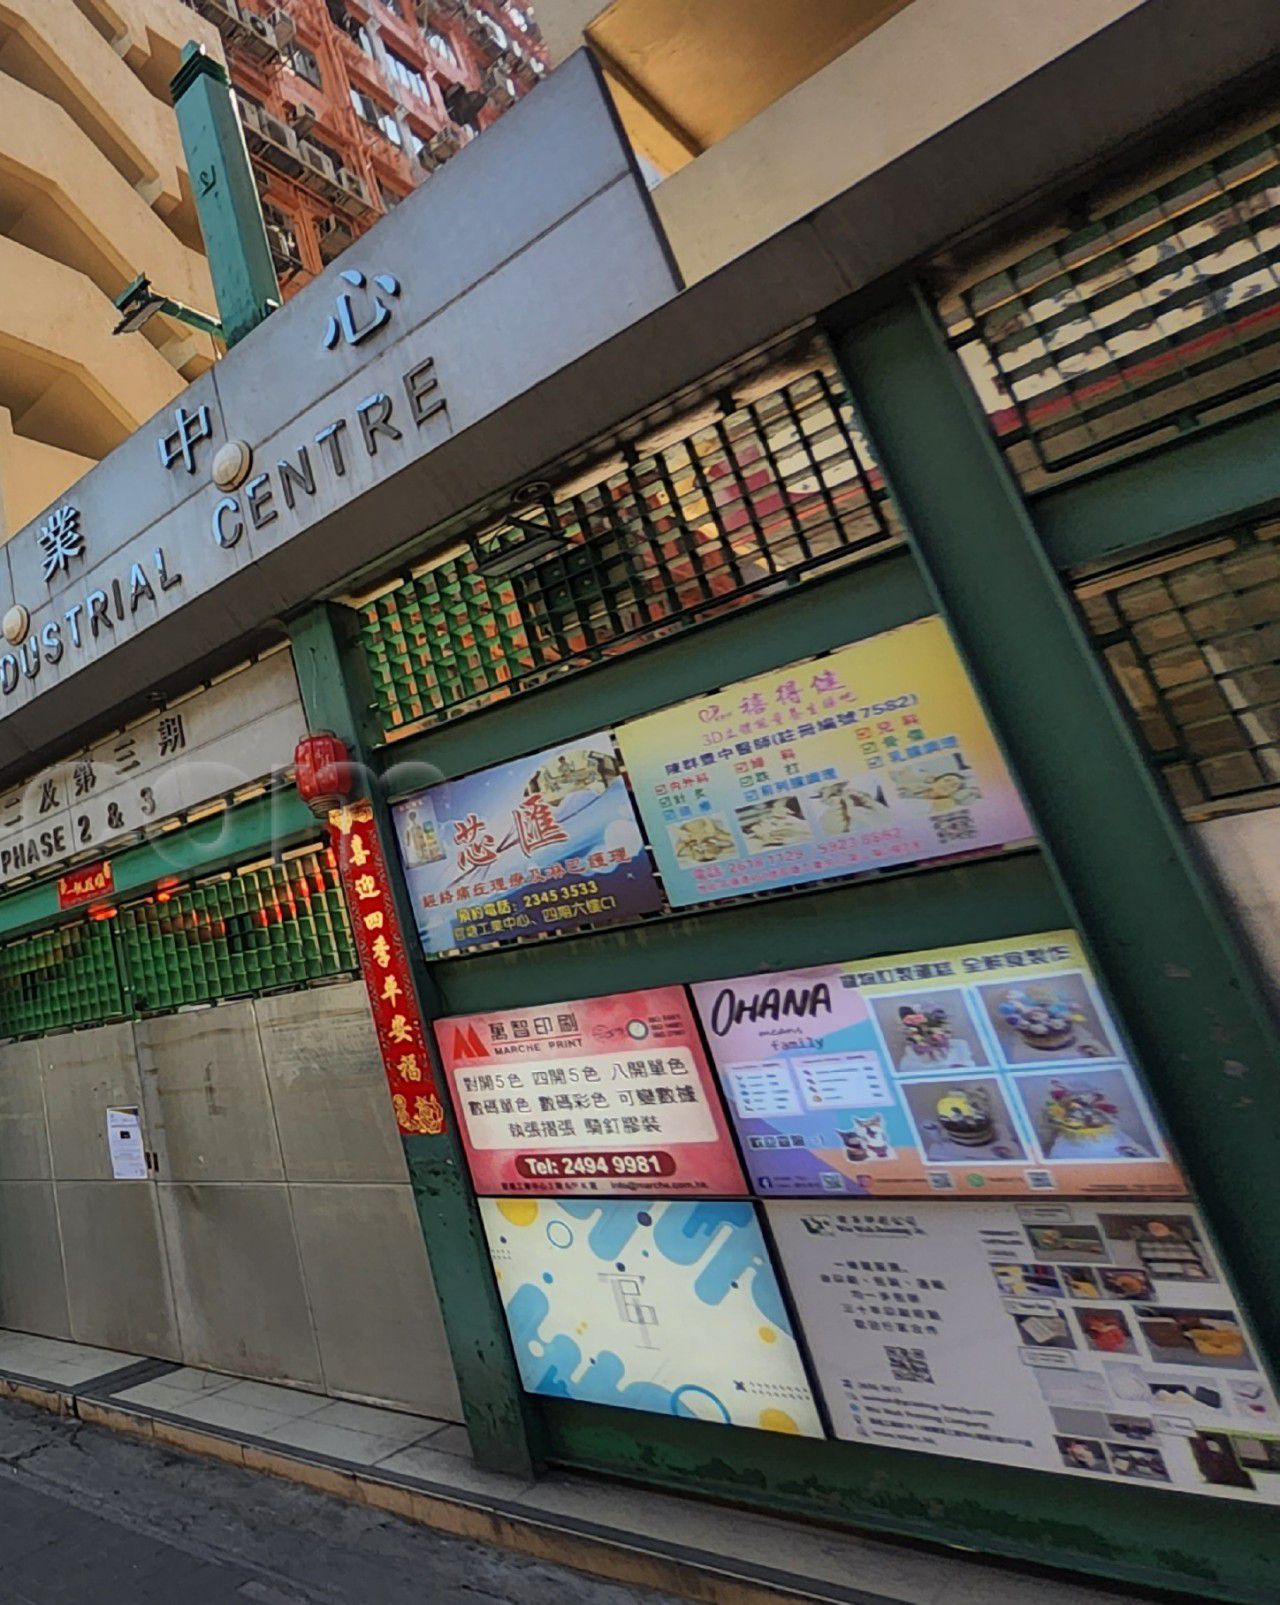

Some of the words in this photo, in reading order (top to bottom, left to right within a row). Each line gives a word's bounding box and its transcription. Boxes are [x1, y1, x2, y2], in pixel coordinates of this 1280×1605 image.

[211, 356, 449, 551] CENTRE
[0, 825, 67, 875] PHASE
[77, 814, 93, 845] 2
[107, 801, 125, 829] &
[140, 786, 157, 815] 3
[523, 886, 558, 908] 2345
[561, 880, 599, 899] 3533
[710, 983, 832, 1037] OHANA
[489, 1012, 579, 1041] 萬智印刷
[494, 1043, 541, 1056] MARCHE
[548, 1038, 583, 1050] PRINT
[771, 1037, 824, 1051] family
[463, 1072, 524, 1093] 對開5色
[532, 1066, 602, 1087] 四開5色
[611, 1057, 689, 1082] 八開單色
[538, 1092, 610, 1113] 數碼彩色
[525, 1157, 558, 1175] Tel:
[561, 1155, 608, 1175] 2494
[615, 1154, 662, 1174] 9981
